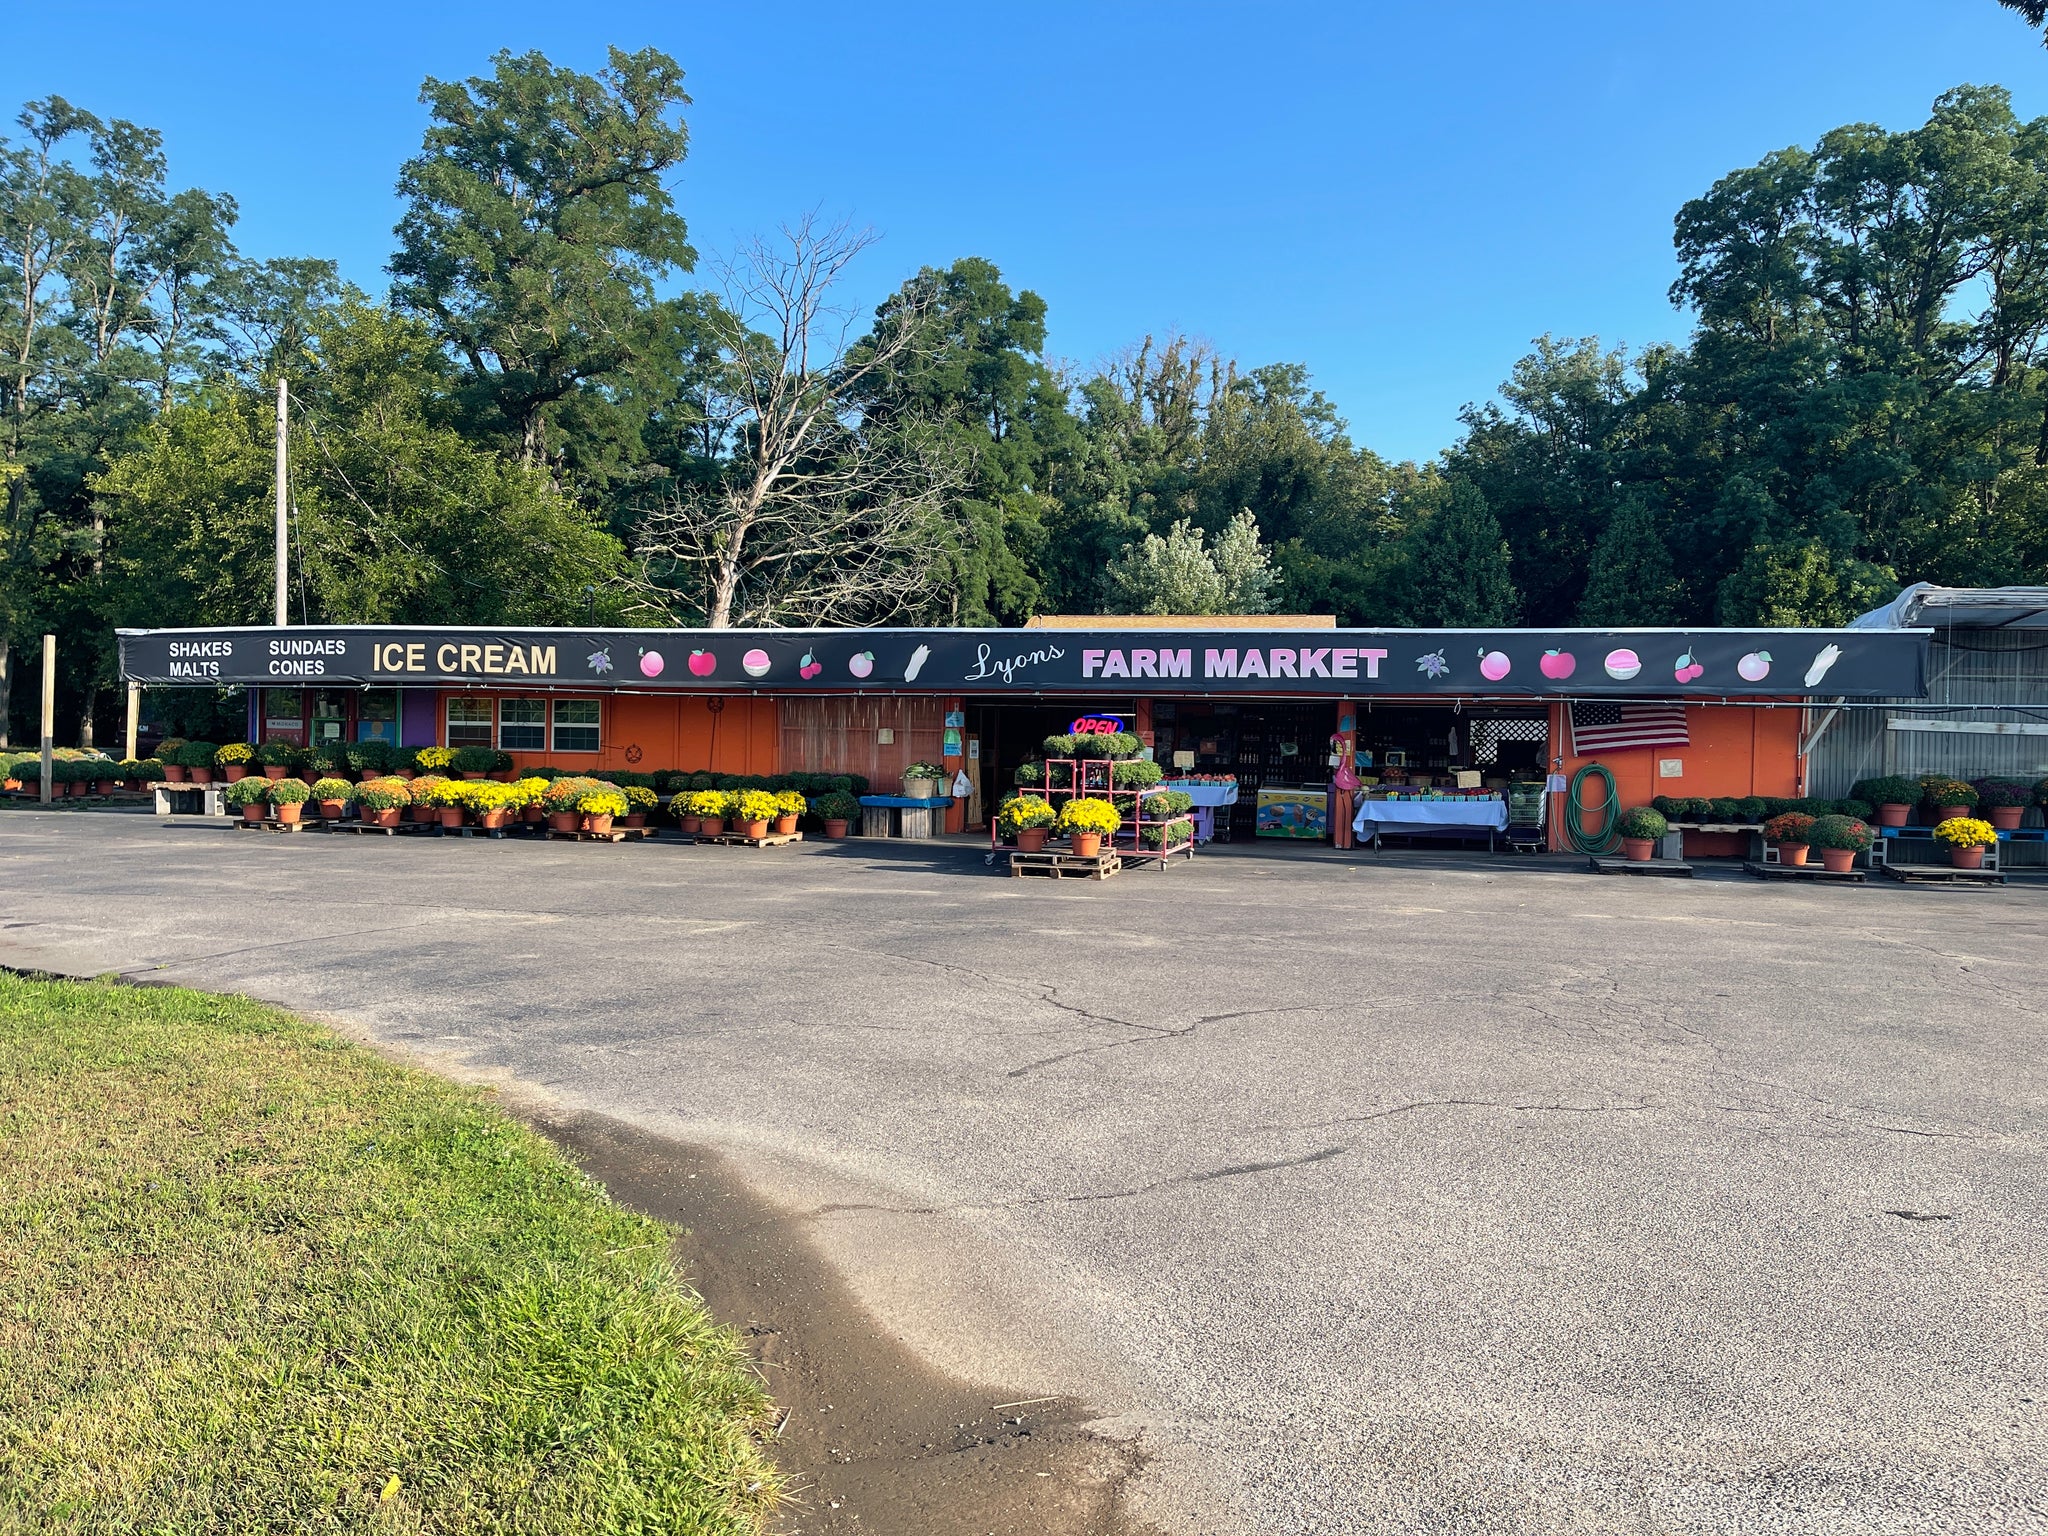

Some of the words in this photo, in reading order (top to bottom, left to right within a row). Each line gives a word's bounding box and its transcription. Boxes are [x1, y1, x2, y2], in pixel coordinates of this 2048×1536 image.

[169, 641, 233, 658] SHAKES
[268, 639, 346, 656] SUNDAES
[268, 659, 325, 676] CONES
[373, 643, 426, 672] ICE
[437, 643, 557, 675] CREAM
[964, 643, 1065, 684] Lyons
[1082, 649, 1192, 678] FARM
[1204, 648, 1388, 678] MARKET
[169, 661, 220, 677] MALTS
[1072, 717, 1119, 735] OPEN
